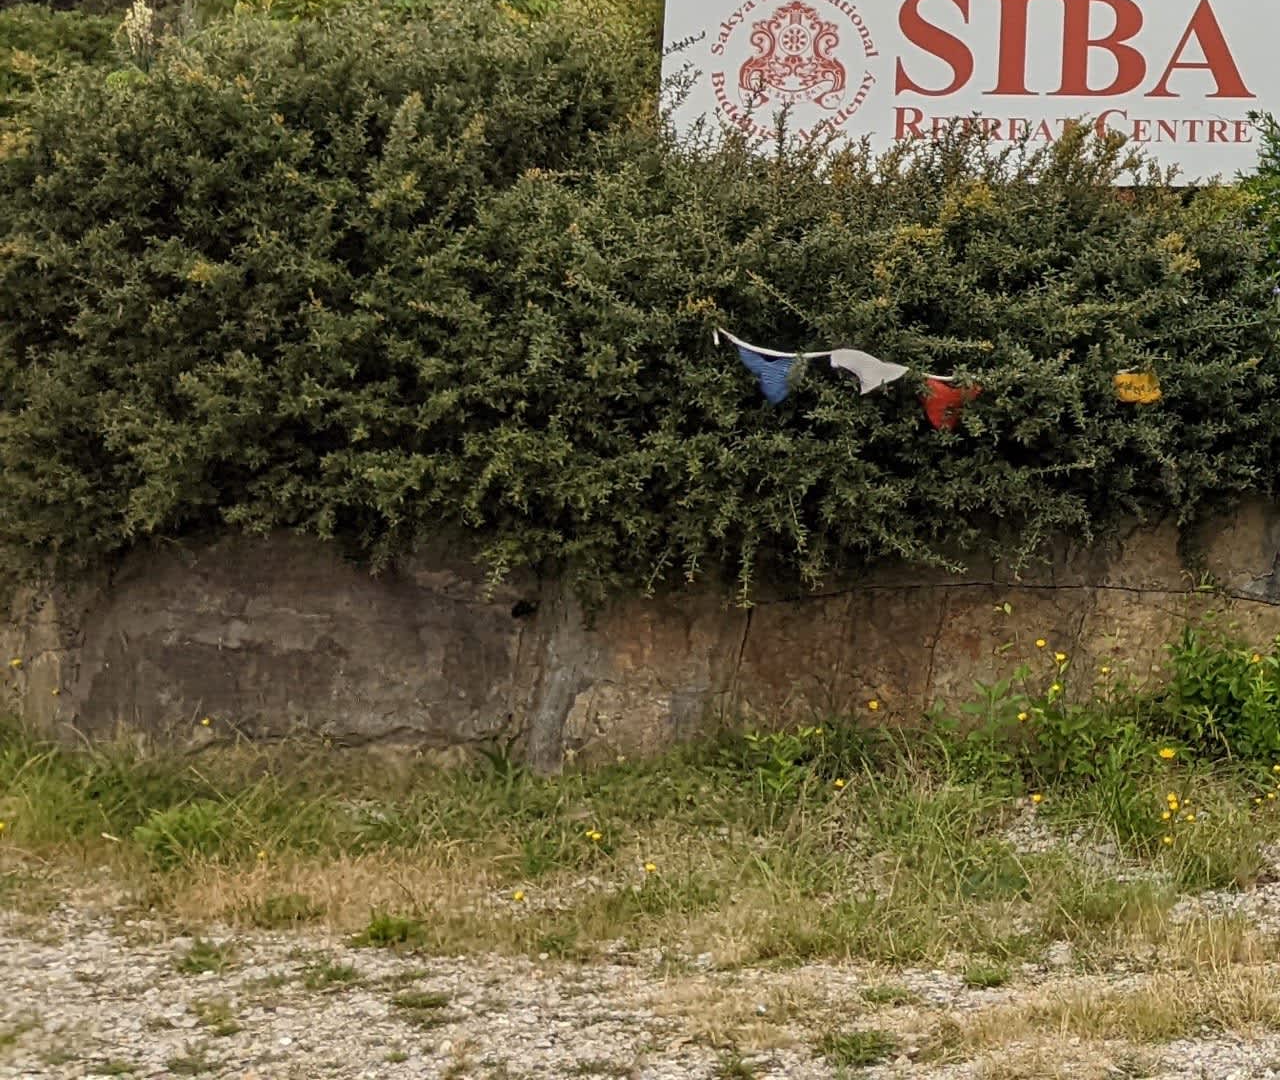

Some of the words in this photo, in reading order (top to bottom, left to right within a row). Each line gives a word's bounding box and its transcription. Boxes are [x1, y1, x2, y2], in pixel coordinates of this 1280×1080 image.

[711, 0, 756, 56] Sakya
[711, 71, 785, 139] Buddhis
[798, 70, 876, 141] ademy
[1094, 109, 1253, 143] CENTRE
